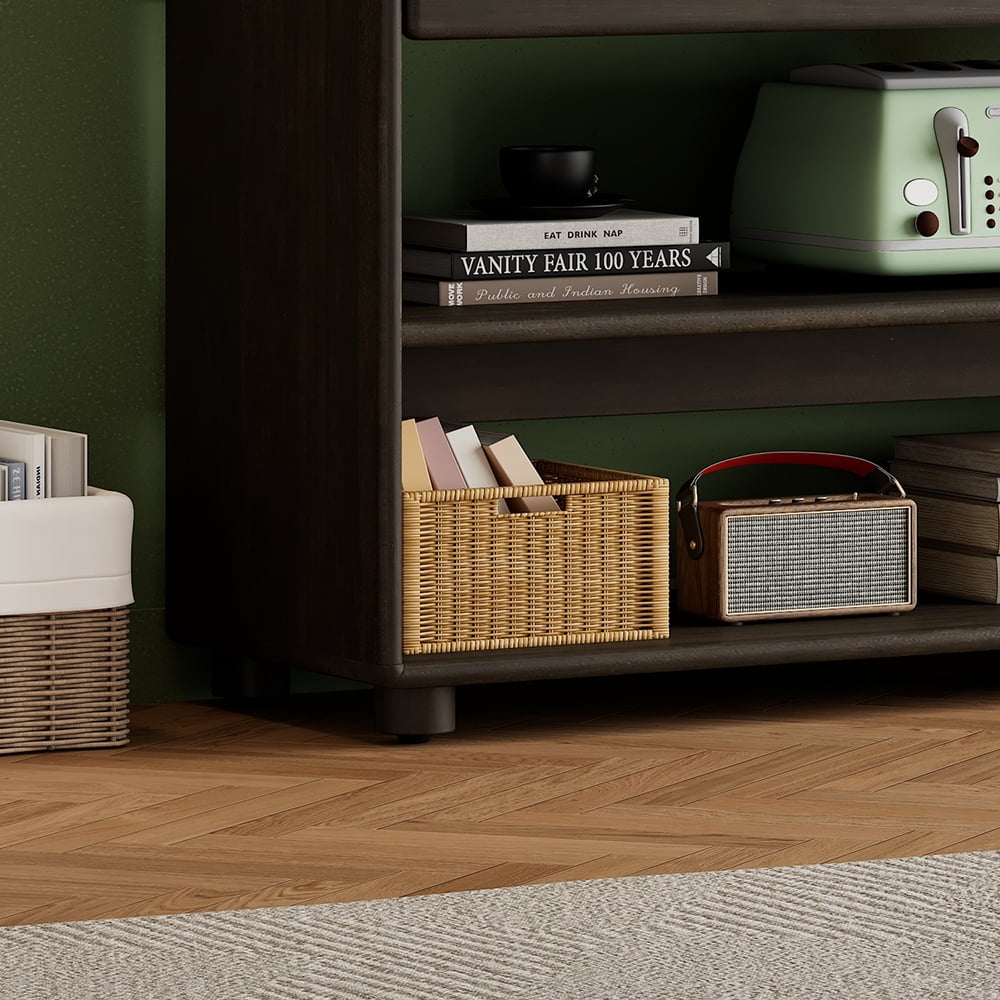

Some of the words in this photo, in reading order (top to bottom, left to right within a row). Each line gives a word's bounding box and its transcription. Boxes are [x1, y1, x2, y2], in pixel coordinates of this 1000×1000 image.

[544, 231, 561, 239] EAT
[567, 230, 597, 239] DRINK
[604, 229, 623, 238] NAP
[461, 254, 538, 276] VANITY
[544, 252, 589, 272] FAIR
[594, 252, 624, 270] 100
[629, 248, 692, 269] YEARS
[475, 287, 520, 301] Public
[527, 286, 556, 298] and
[562, 285, 614, 298] Indian
[620, 283, 680, 296] Housing
